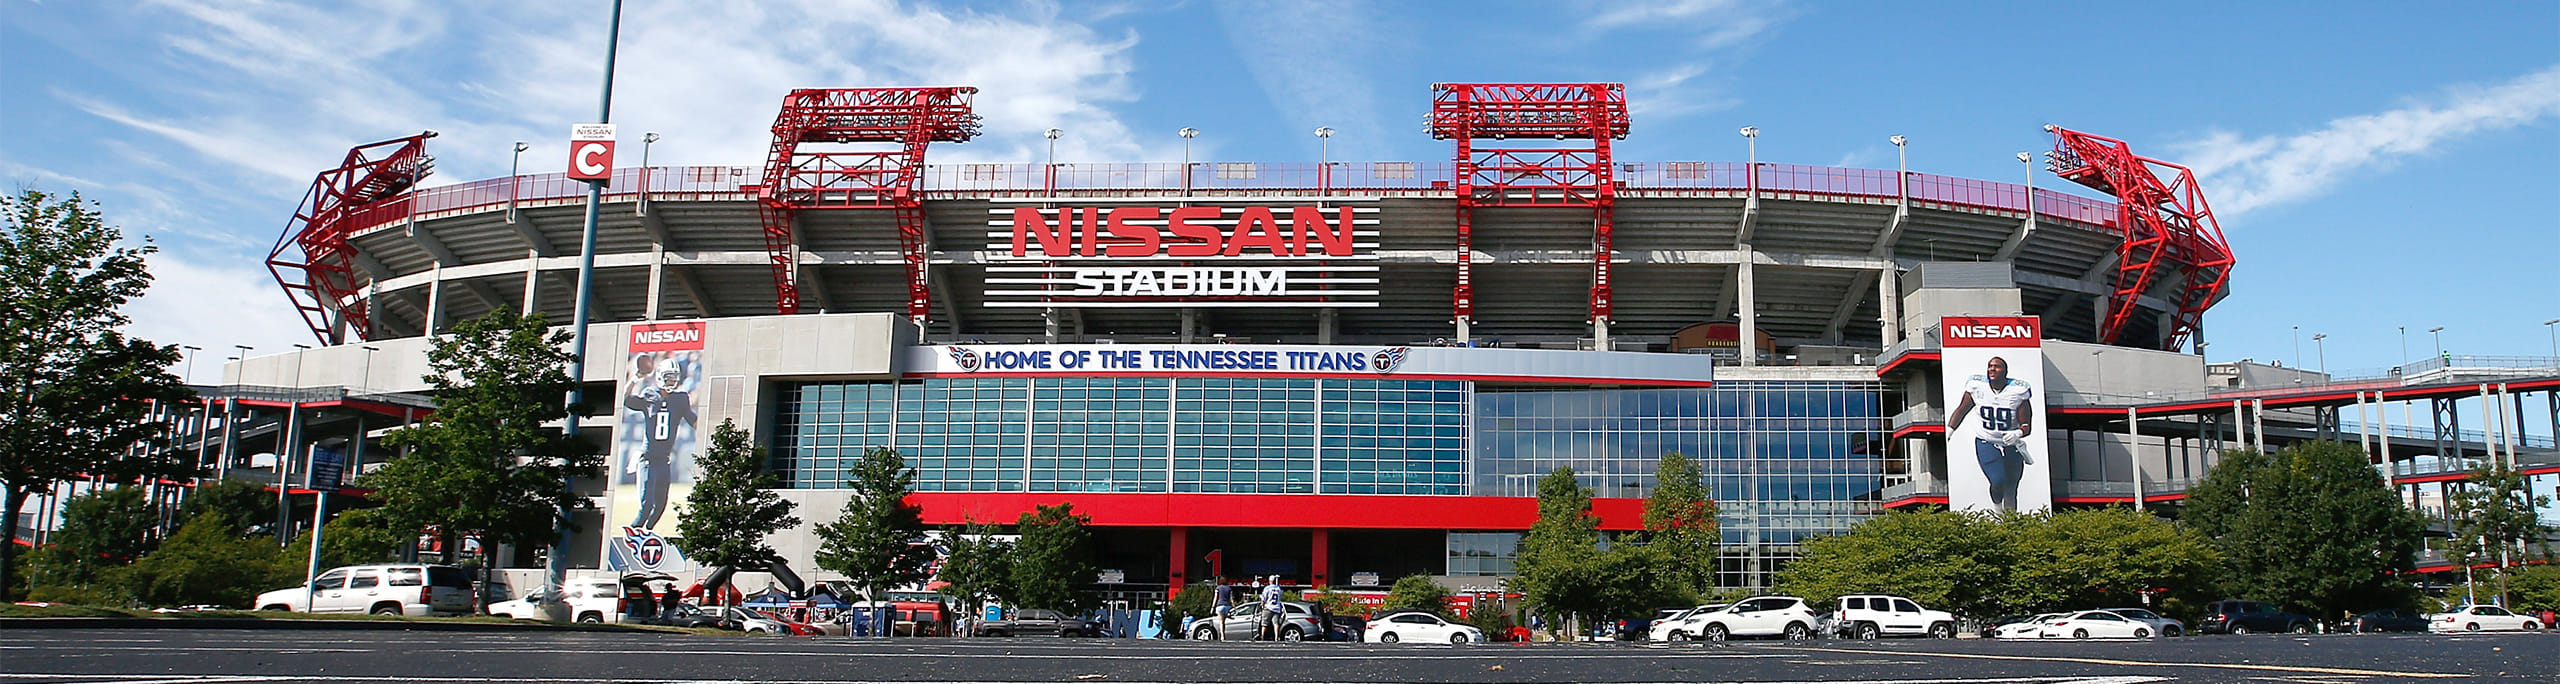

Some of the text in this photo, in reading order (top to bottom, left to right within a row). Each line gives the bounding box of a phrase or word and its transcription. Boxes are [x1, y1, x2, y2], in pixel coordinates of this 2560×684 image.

[575, 143, 608, 176] C
[1011, 206, 1354, 257] NISSAN
[1073, 269, 1288, 297] STADIUM
[634, 329, 700, 345] NISSAN
[1949, 324, 2032, 339] NISSAN
[984, 350, 1367, 371] HOME OF THE TENNESSEE TITANS
[654, 411, 670, 441] 8
[1979, 405, 2012, 431] 99
[1204, 548, 1222, 577] 1
